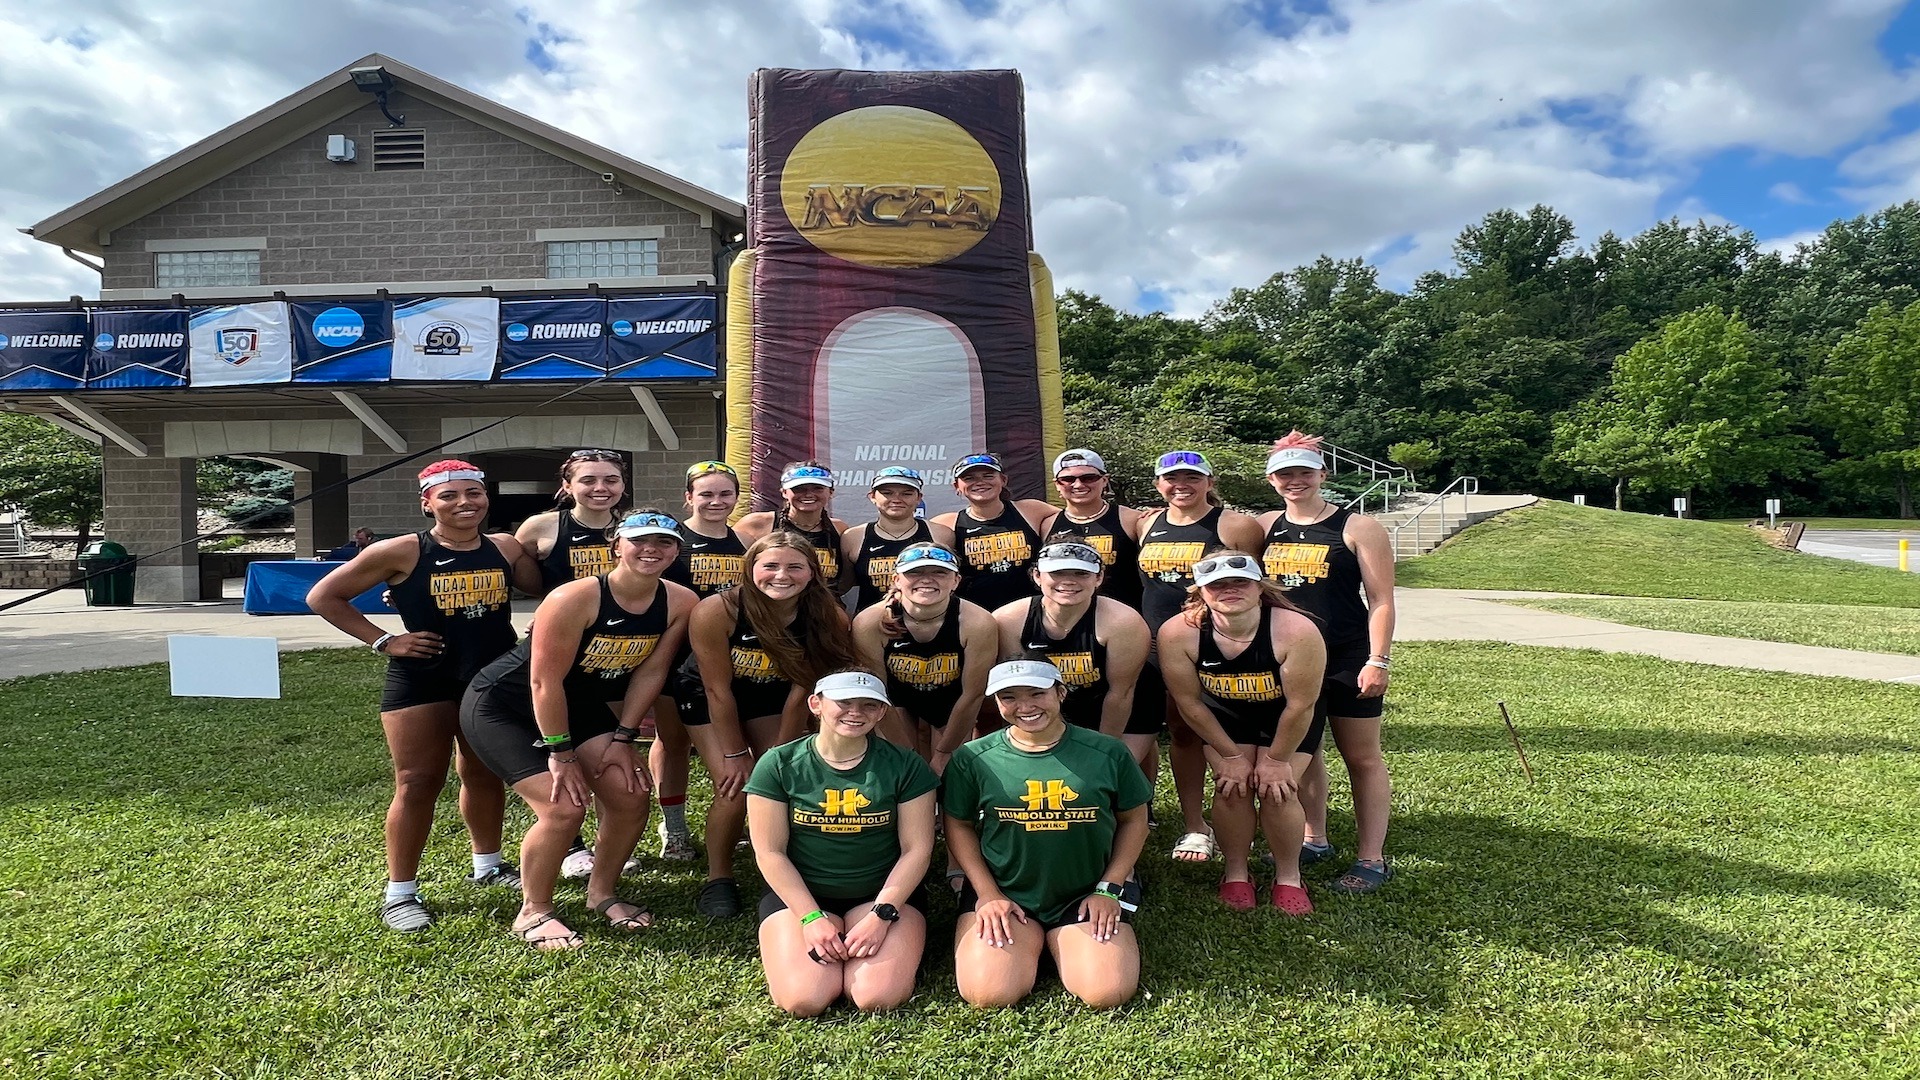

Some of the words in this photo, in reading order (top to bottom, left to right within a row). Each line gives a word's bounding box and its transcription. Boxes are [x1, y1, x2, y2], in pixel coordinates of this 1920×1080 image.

[799, 184, 992, 230] NCAA
[316, 326, 363, 338] NCAA
[532, 322, 602, 340] ROWING
[10, 334, 84, 348] WELCOME
[117, 333, 185, 348] ROWING
[224, 336, 250, 351] 50
[430, 332, 457, 348] 50
[854, 444, 948, 461] NATIONAL
[966, 540, 992, 553] NCAA
[996, 536, 1012, 550] DIV
[1016, 535, 1026, 548] II
[573, 550, 602, 563] NCAA
[968, 544, 1032, 566] CHAMPIONS
[1168, 548, 1188, 558] DIV
[1265, 548, 1290, 560] NCAA
[1293, 548, 1312, 562] DIV
[693, 558, 721, 570] NCAA
[726, 558, 740, 571] DIV
[434, 578, 467, 592] NCAA
[472, 576, 492, 590] DIV
[497, 574, 504, 588] II
[435, 586, 508, 610] CHAMPIONS
[588, 640, 622, 655] NCAA
[625, 642, 646, 655] DIV
[926, 658, 942, 674] DIV
[1082, 658, 1090, 672] II
[1238, 678, 1258, 692] DIV
[1264, 678, 1273, 691] II
[818, 788, 872, 816] H
[1020, 780, 1080, 810] H
[794, 813, 809, 823] CAL
[811, 815, 836, 824] POLY
[838, 814, 890, 824] HUMBOLDT
[998, 811, 1060, 820] HUMBOLDT
[1064, 810, 1096, 819] STATE
